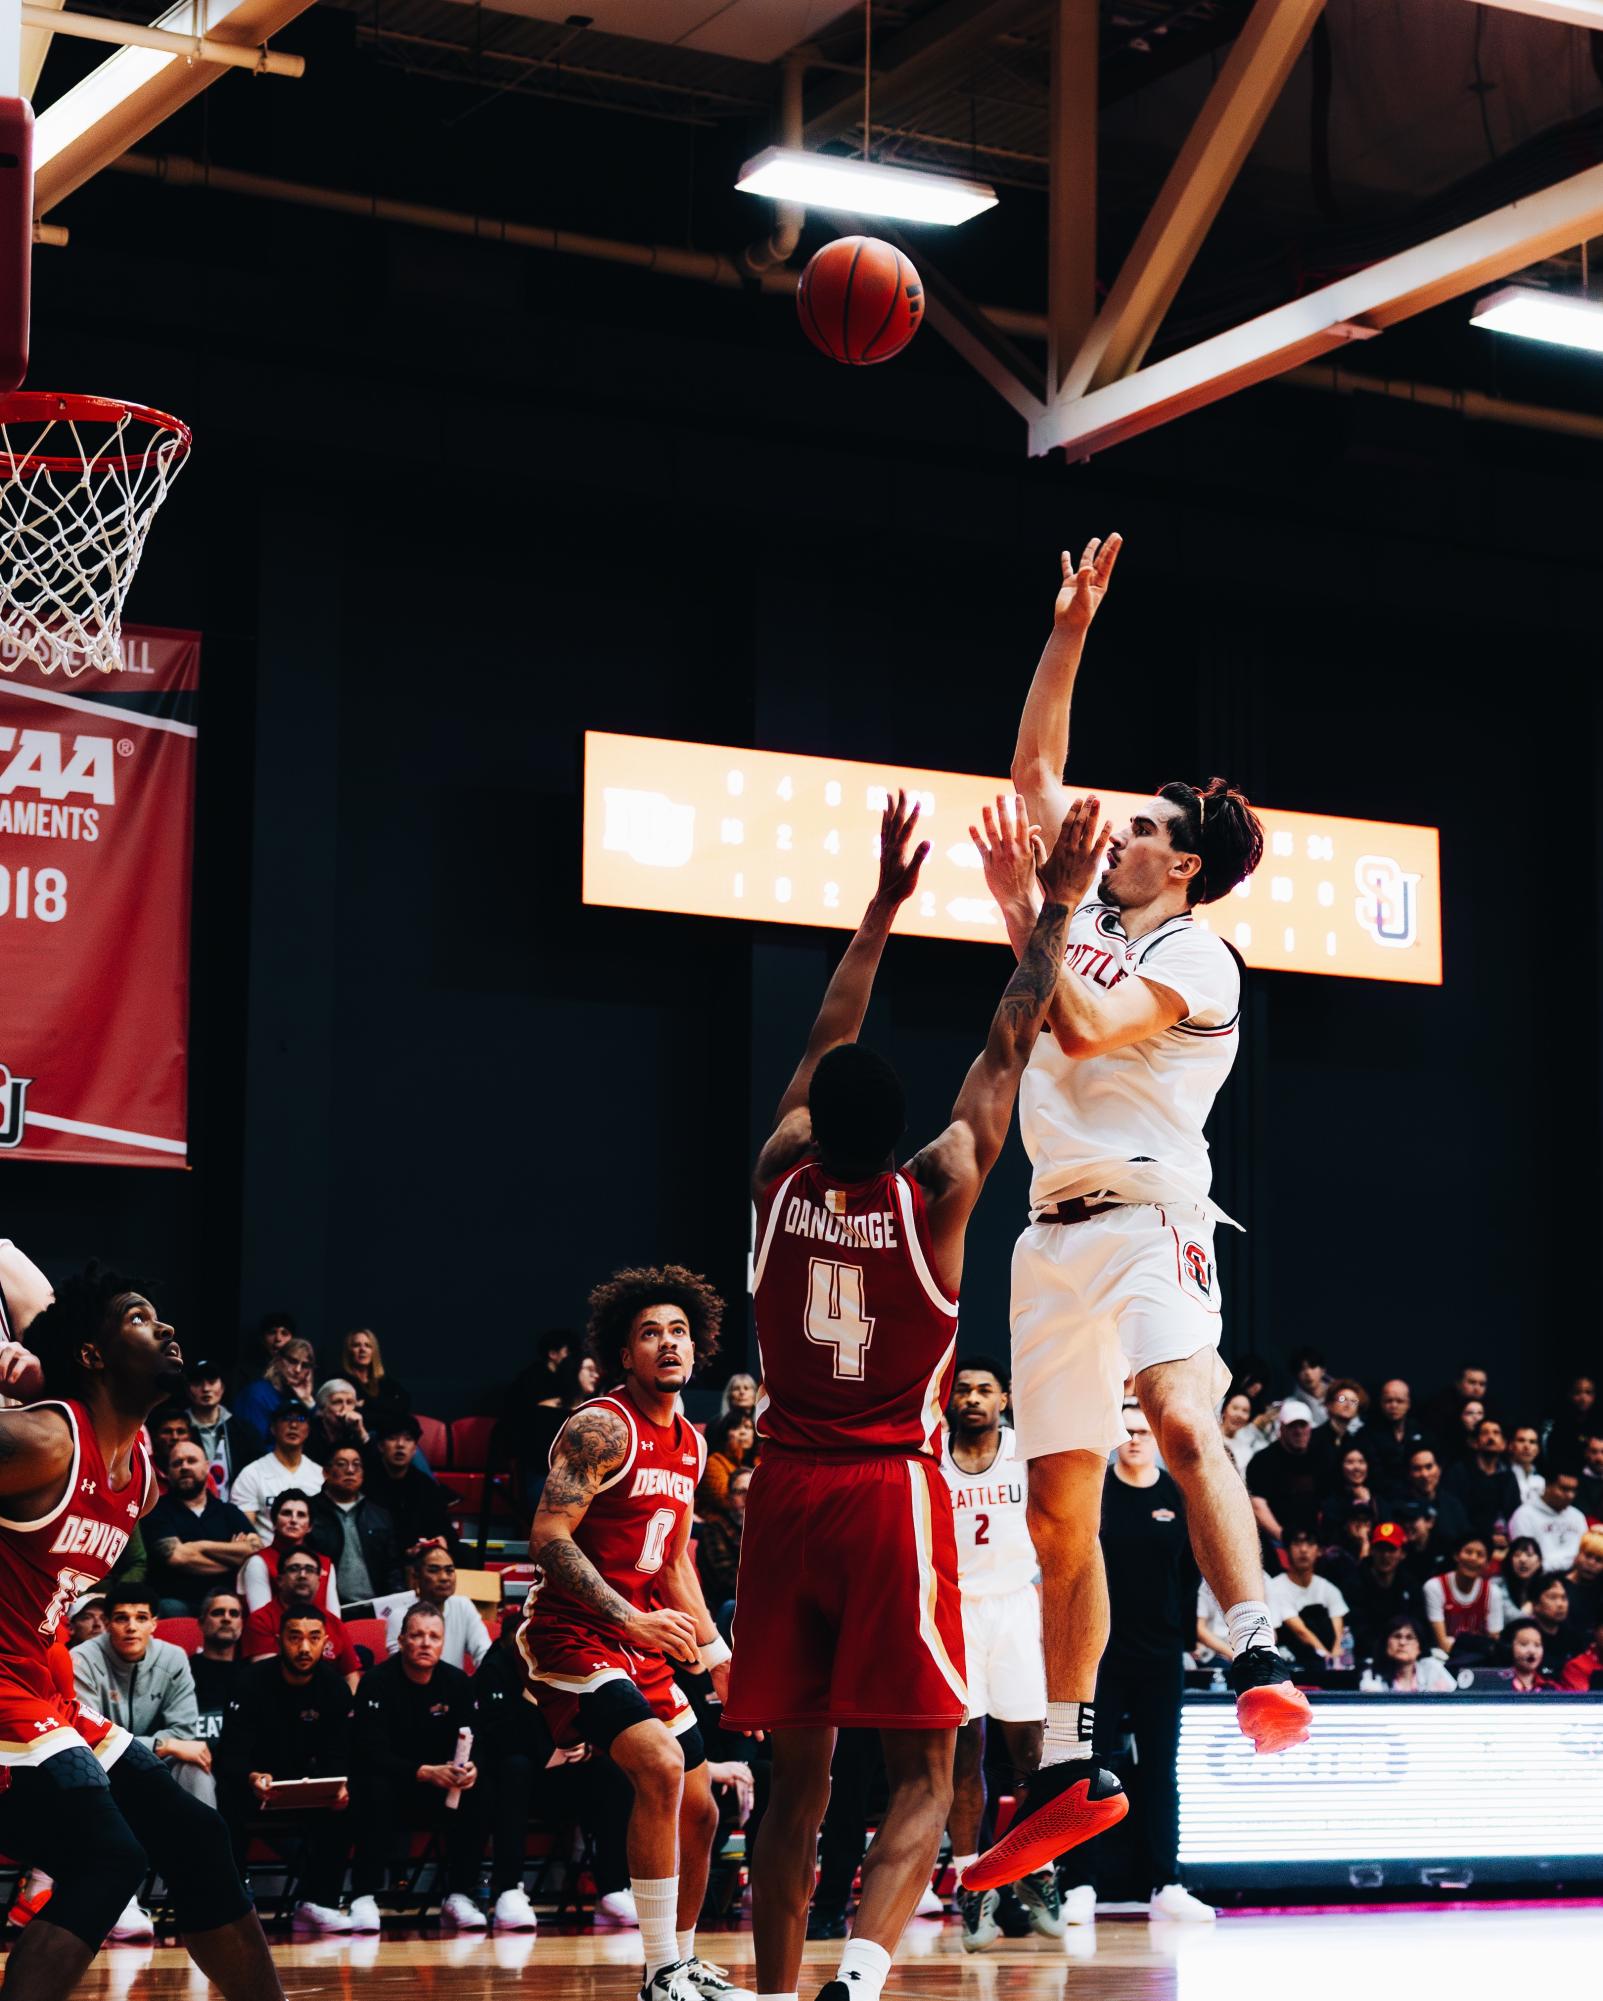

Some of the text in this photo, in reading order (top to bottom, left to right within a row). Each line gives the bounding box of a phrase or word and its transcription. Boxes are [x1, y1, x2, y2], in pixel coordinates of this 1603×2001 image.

[0, 800, 99, 841] AMENTS
[0, 863, 68, 923] 18
[803, 1256, 876, 1382] 4
[629, 1467, 695, 1505] DENVER
[635, 1508, 677, 1574] 0
[975, 1513, 990, 1546] 2
